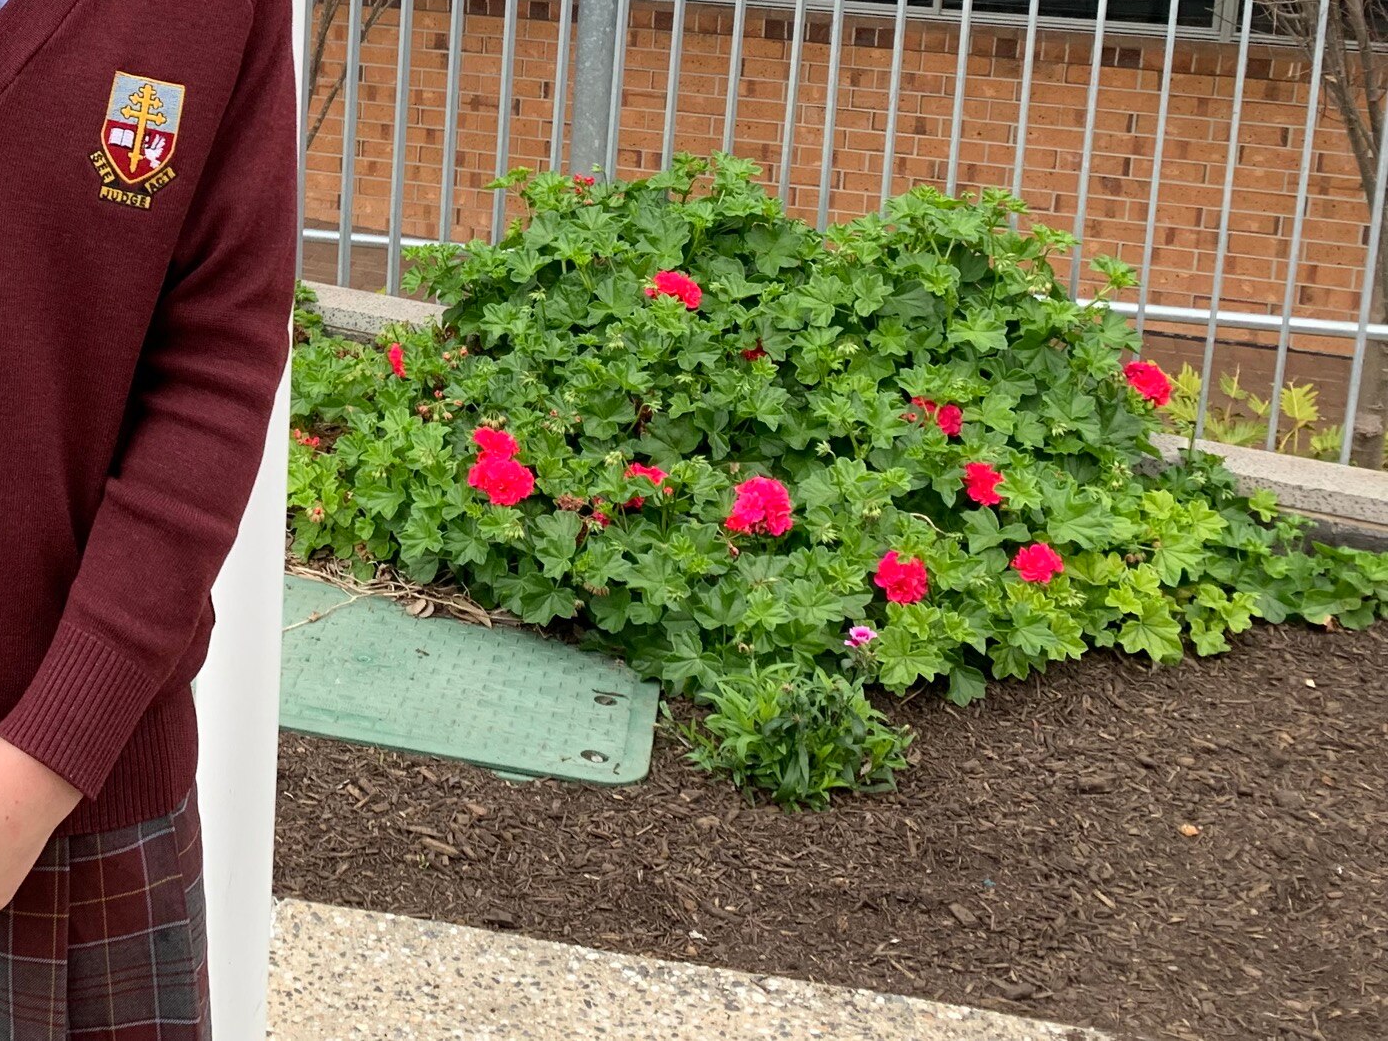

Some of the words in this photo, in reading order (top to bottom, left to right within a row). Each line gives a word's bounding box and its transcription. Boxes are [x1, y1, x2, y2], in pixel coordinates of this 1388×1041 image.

[91, 152, 114, 182] SEE
[146, 168, 174, 193] ACT
[101, 187, 150, 208] JUDGE
